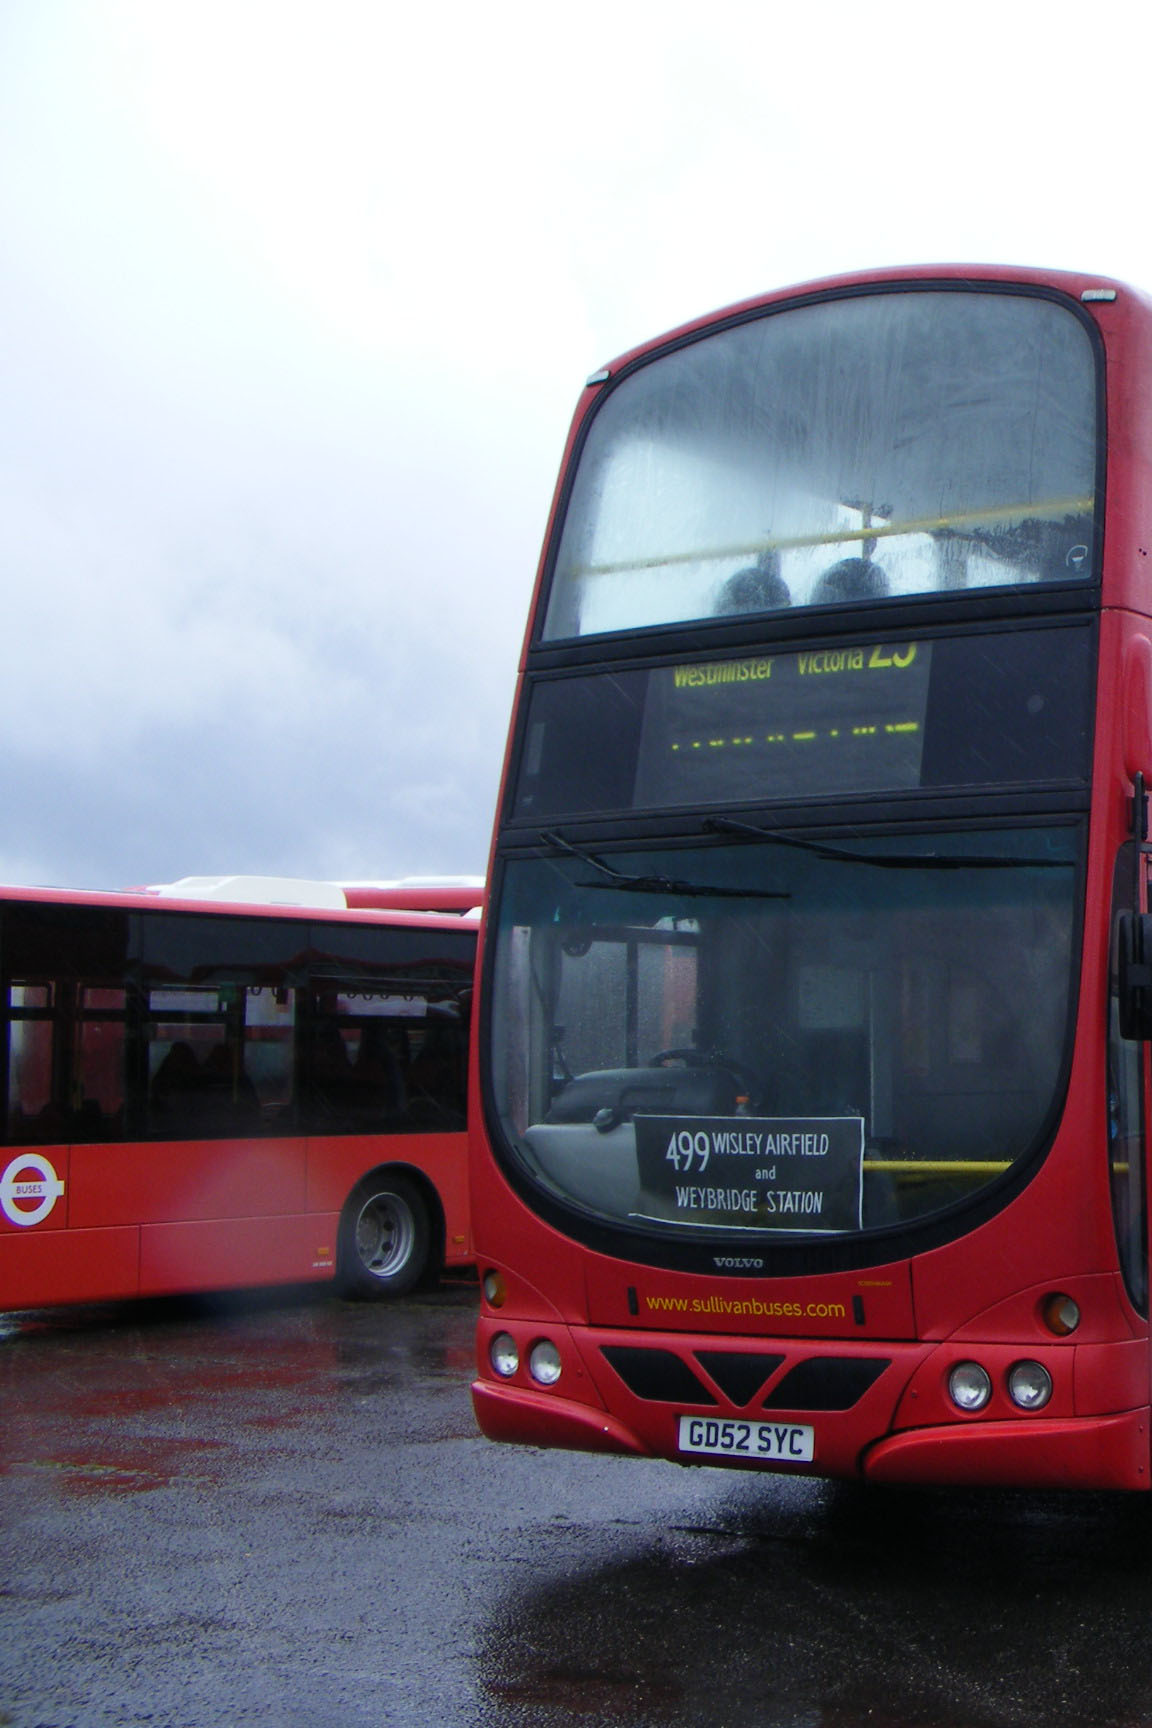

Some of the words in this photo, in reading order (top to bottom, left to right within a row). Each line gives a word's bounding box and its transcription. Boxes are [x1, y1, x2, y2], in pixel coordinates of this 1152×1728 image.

[674, 657, 774, 688] Westminster
[666, 1131, 710, 1172] 499
[712, 1132, 763, 1155] WISLEY
[765, 1133, 829, 1156] AIRFIELD
[755, 1166, 776, 1180] and
[16, 1184, 42, 1194] BUSES
[676, 1186, 758, 1212] WEYBRIDGE
[767, 1190, 823, 1213] STATION
[713, 1256, 764, 1268] VOLVO
[646, 1296, 846, 1318] www.sullivanbuses.com
[689, 1420, 750, 1451] GD52
[757, 1426, 804, 1455] SYC
